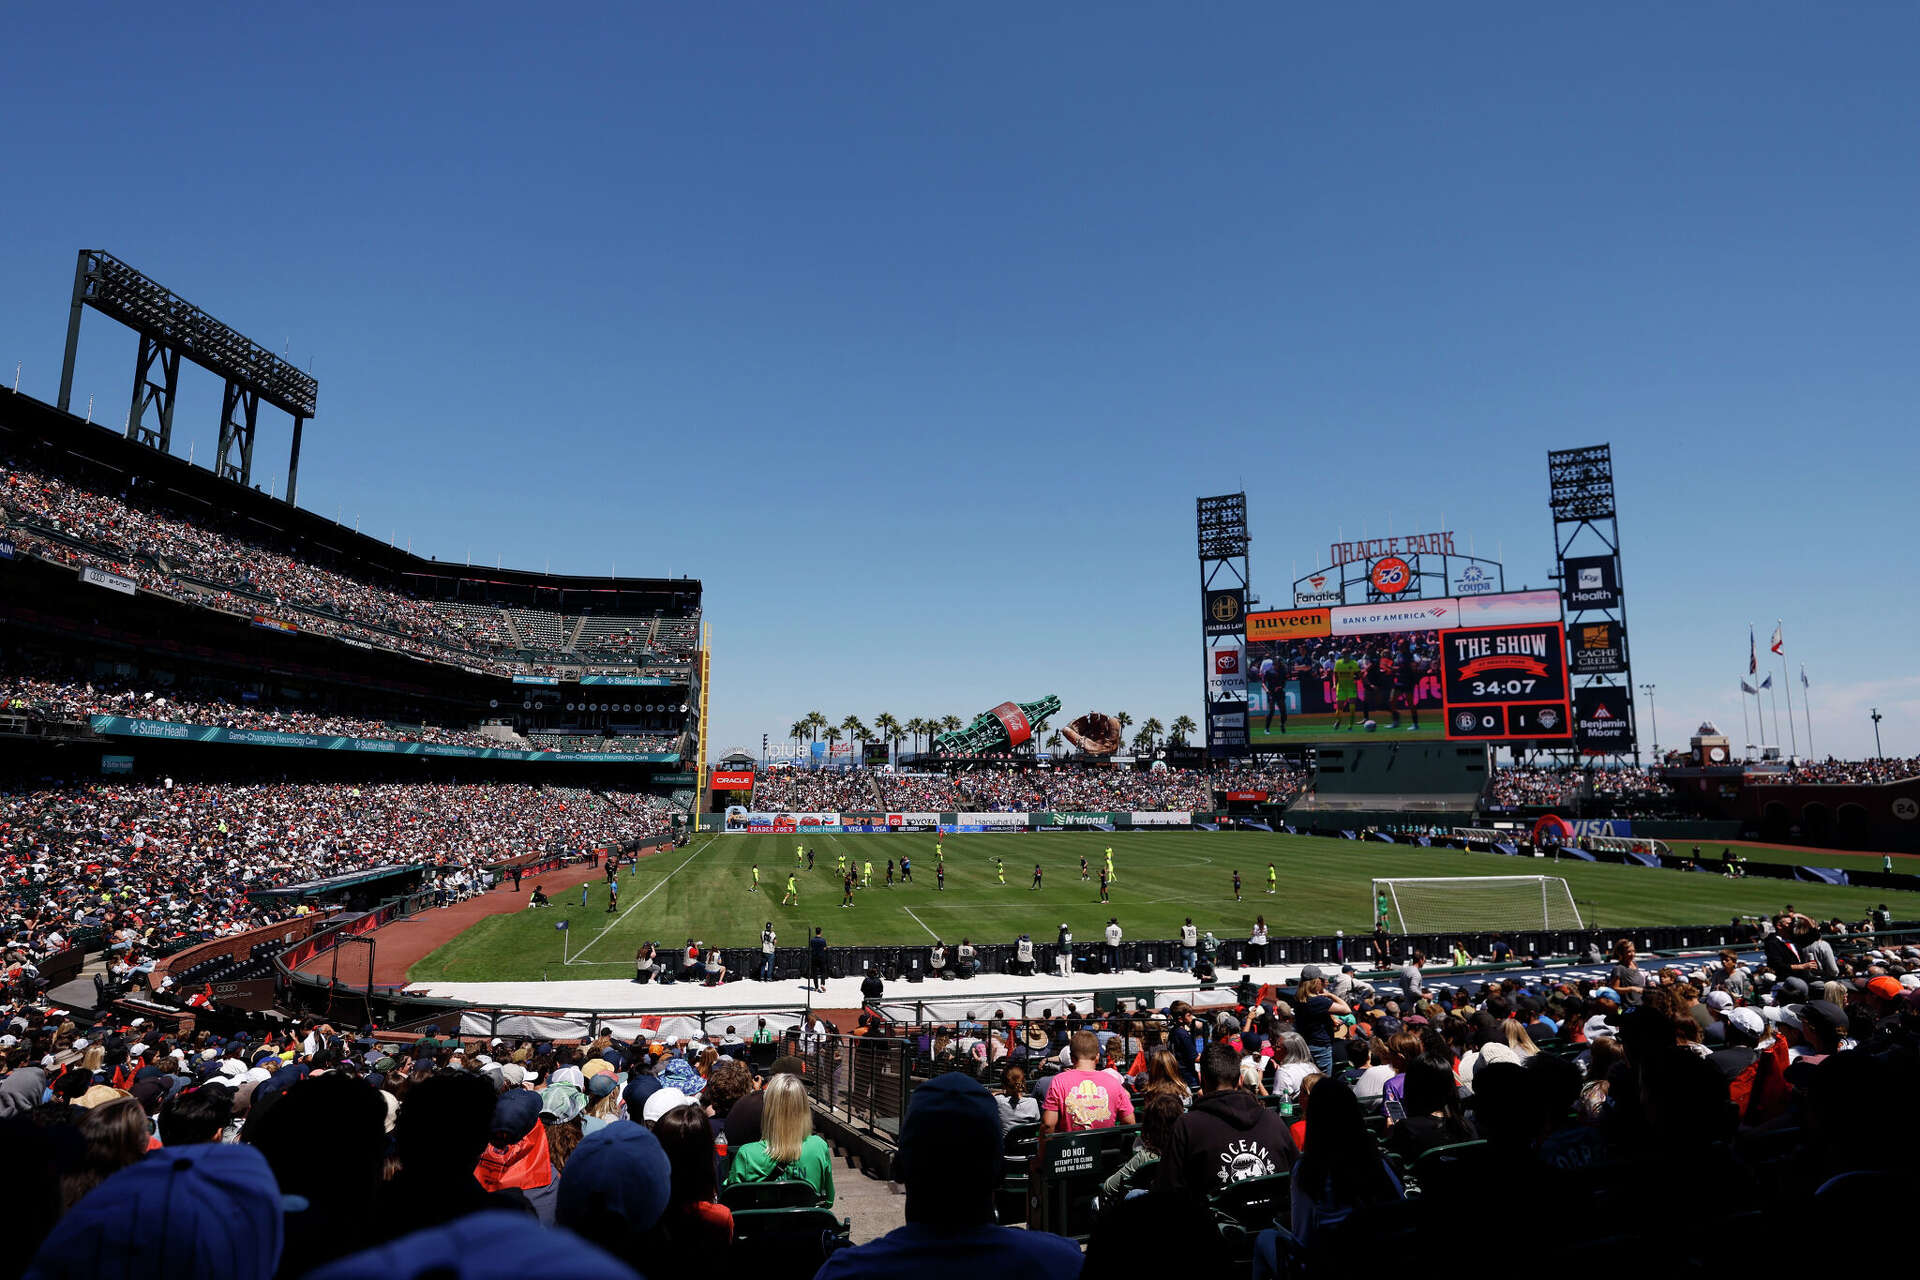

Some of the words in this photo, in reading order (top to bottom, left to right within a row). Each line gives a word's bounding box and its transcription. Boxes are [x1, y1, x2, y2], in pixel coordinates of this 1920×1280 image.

[1330, 538, 1400, 567] ORACLE
[1405, 530, 1456, 556] PARK
[1379, 566, 1402, 584] 76
[1457, 581, 1491, 595] coupa
[1295, 591, 1342, 604] Fanatics
[1572, 590, 1612, 602] Health
[1255, 614, 1322, 629] nuveen
[1343, 616, 1367, 625] BANK
[1383, 612, 1426, 622] AMERICA
[1455, 637, 1491, 661] THE
[1496, 634, 1546, 657] SHOW
[1577, 648, 1618, 658] CACHE
[1578, 656, 1616, 666] CREEK
[638, 677, 661, 685] Health
[1209, 679, 1245, 687] TOYOTA
[1472, 680, 1536, 696] 34:07
[1482, 715, 1495, 728] 0
[1519, 715, 1525, 727] 1
[1579, 719, 1626, 731] Benjamin
[139, 723, 164, 735] Sutter
[164, 724, 189, 737] Health
[1587, 728, 1622, 737] Moore
[228, 731, 277, 745] Game-Changing
[276, 735, 305, 746] Neurology
[360, 740, 378, 749] Sutter
[378, 742, 395, 751] Health
[768, 743, 808, 758] blue
[555, 753, 603, 761] Game-Changing
[604, 753, 634, 761] Neurology
[1896, 804, 1914, 814] 24
[1065, 815, 1109, 825] National
[749, 825, 775, 833] TRADER
[775, 825, 794, 833] JOE'S
[1573, 820, 1616, 837] VISA
[1061, 1148, 1071, 1158] DO
[1072, 1147, 1086, 1157] NOT
[1219, 1138, 1270, 1165] OCEAN
[1054, 1158, 1073, 1167] ATTEMPT
[1080, 1155, 1093, 1163] CLIMB
[1054, 1166, 1067, 1174] OVER
[1075, 1163, 1094, 1171] RAILING
